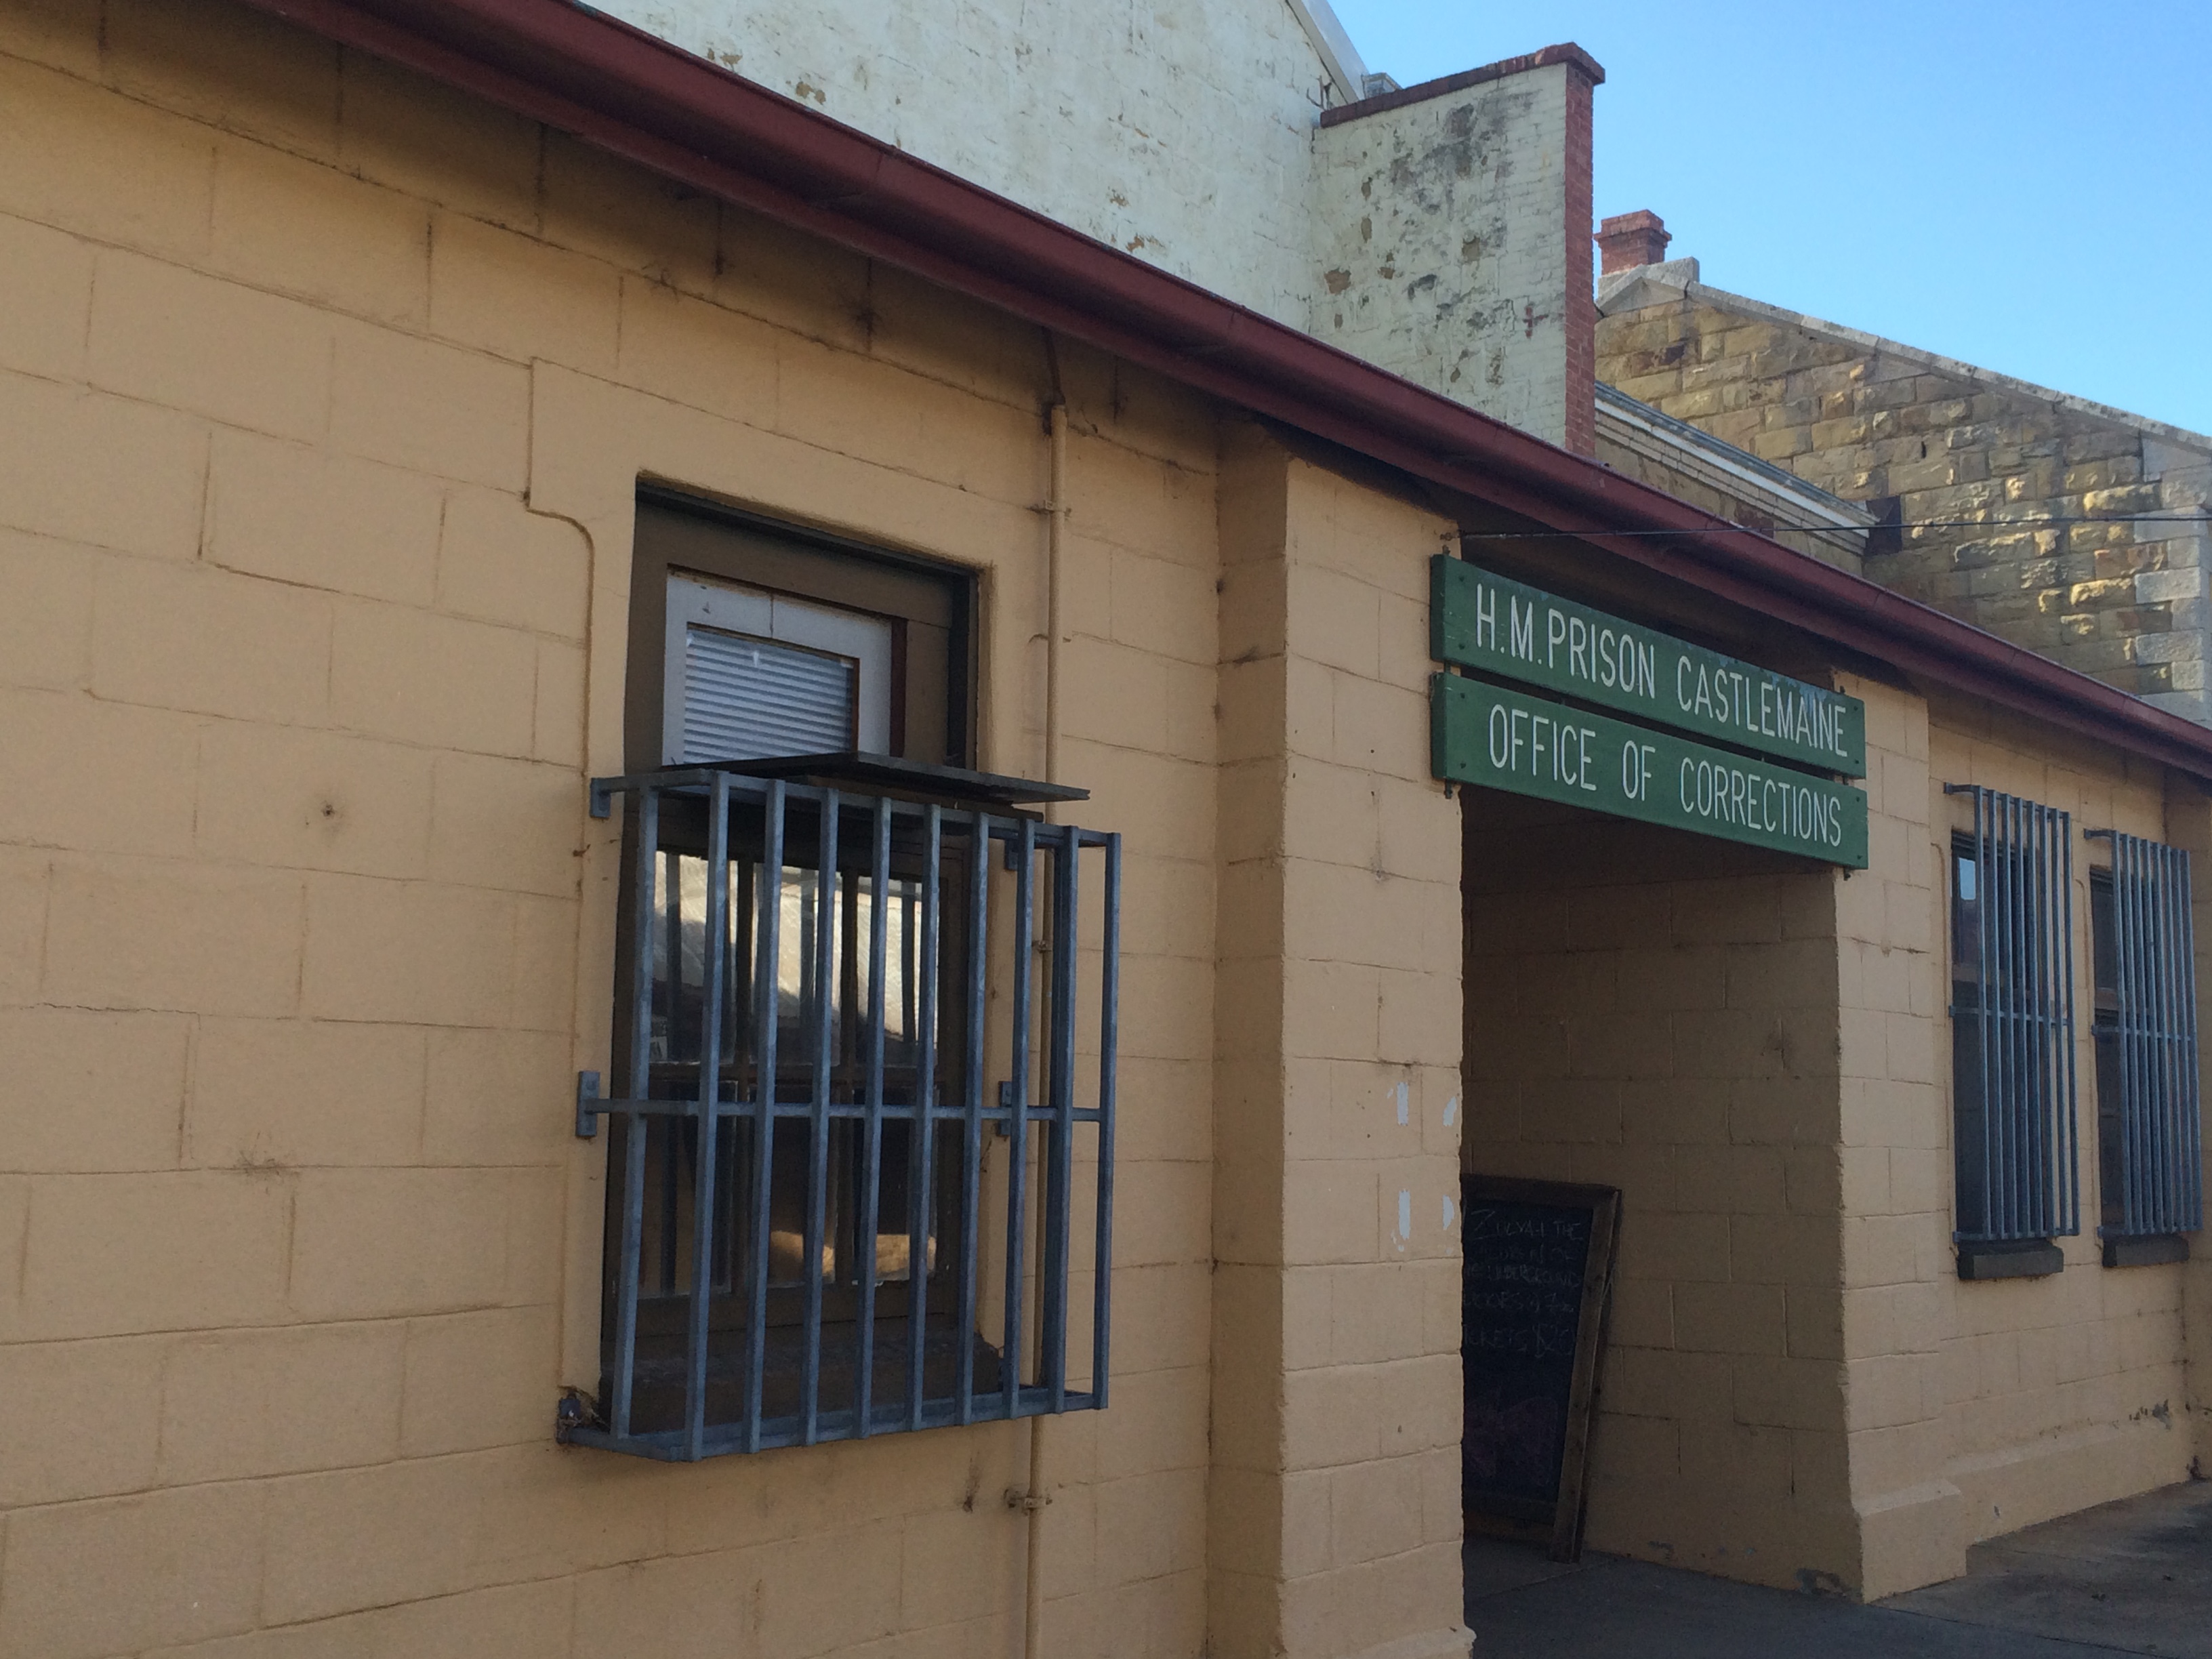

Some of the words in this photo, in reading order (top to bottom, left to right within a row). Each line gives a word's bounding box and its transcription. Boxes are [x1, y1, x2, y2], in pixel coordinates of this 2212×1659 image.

[1677, 655, 1848, 758] CASTLEMAINE
[1489, 703, 1597, 792] OFFICE
[1622, 739, 1656, 802] OF
[1680, 757, 1842, 847] CORRECTIONS
